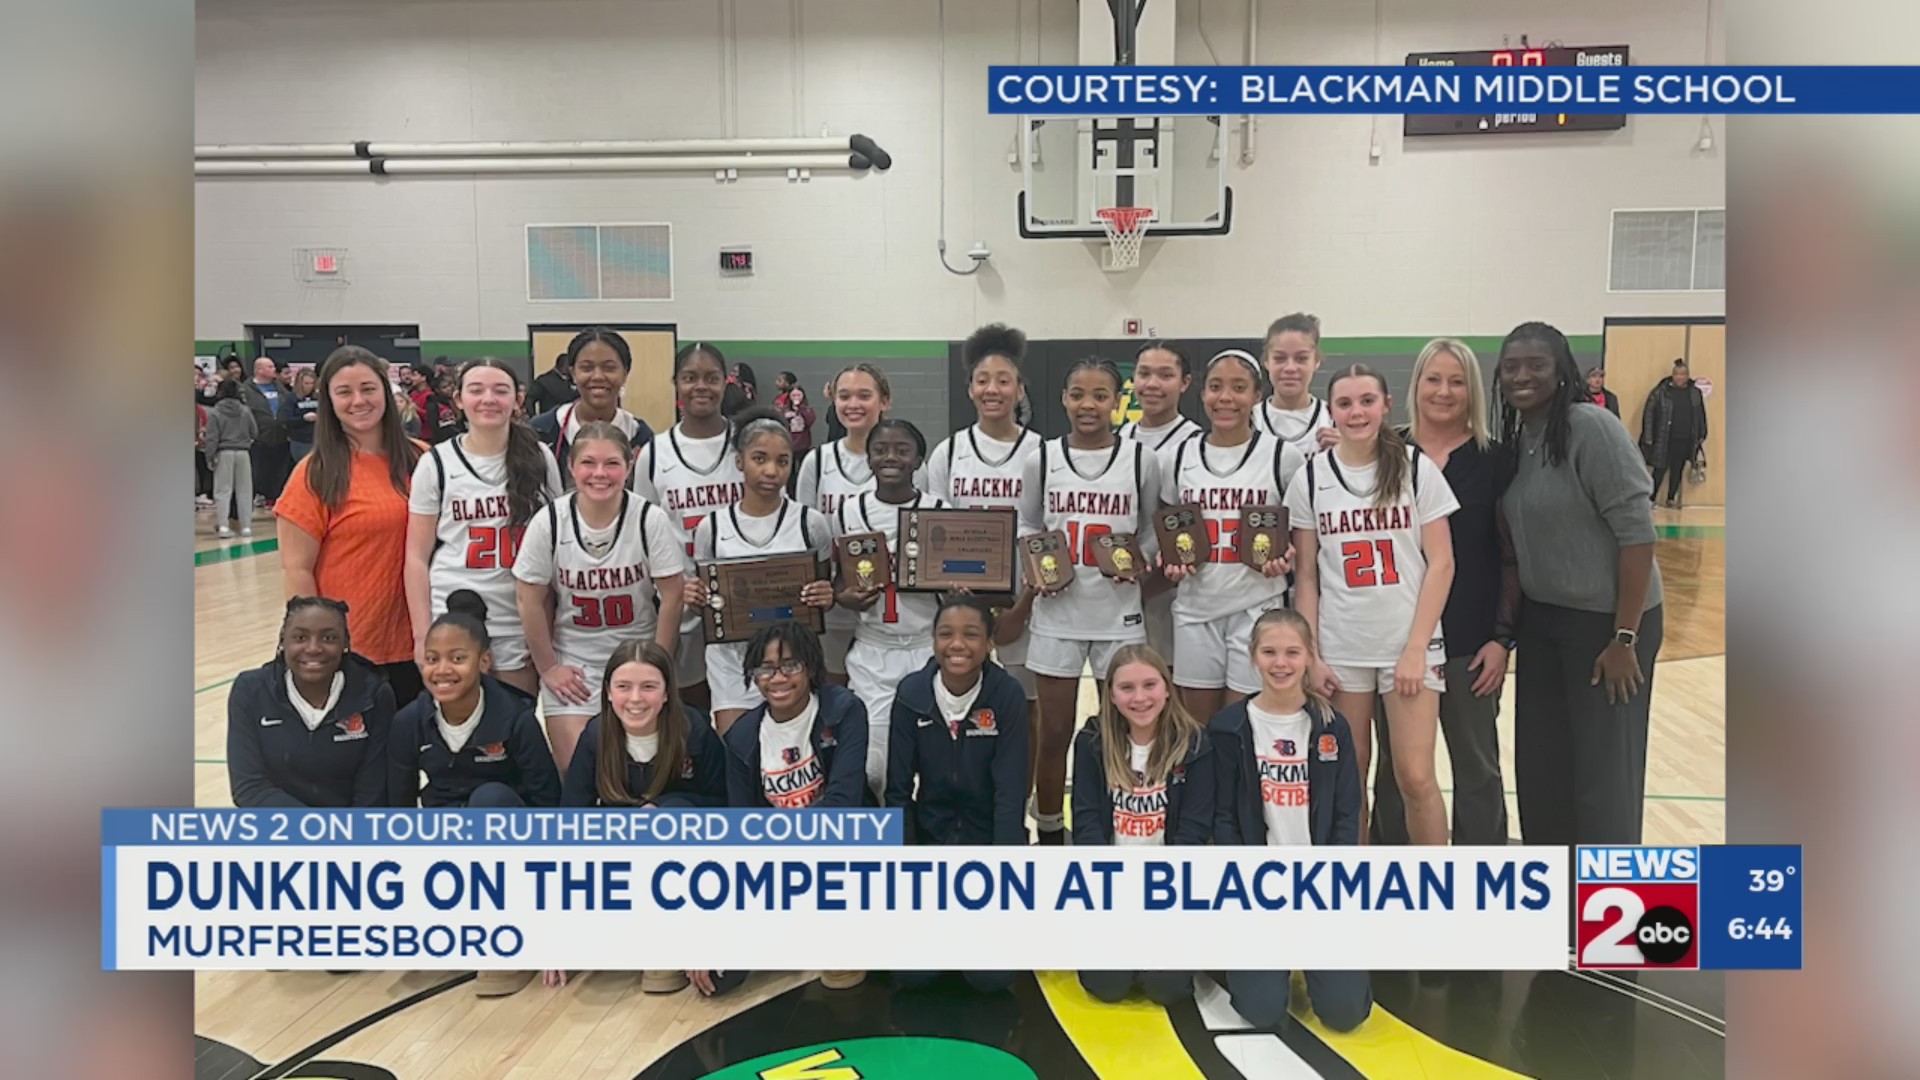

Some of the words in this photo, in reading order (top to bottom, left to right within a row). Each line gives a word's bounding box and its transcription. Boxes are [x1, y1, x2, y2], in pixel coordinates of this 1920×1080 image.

[1577, 52, 1623, 66] Guests
[954, 477, 1023, 498] BLACKMA
[452, 495, 510, 522] BLACK
[1049, 491, 1132, 516] BLACKMAN
[1319, 505, 1413, 535] BLACKMAN
[559, 560, 647, 591] BLACKMAN
[1341, 538, 1401, 588] 21
[571, 593, 635, 628] 30
